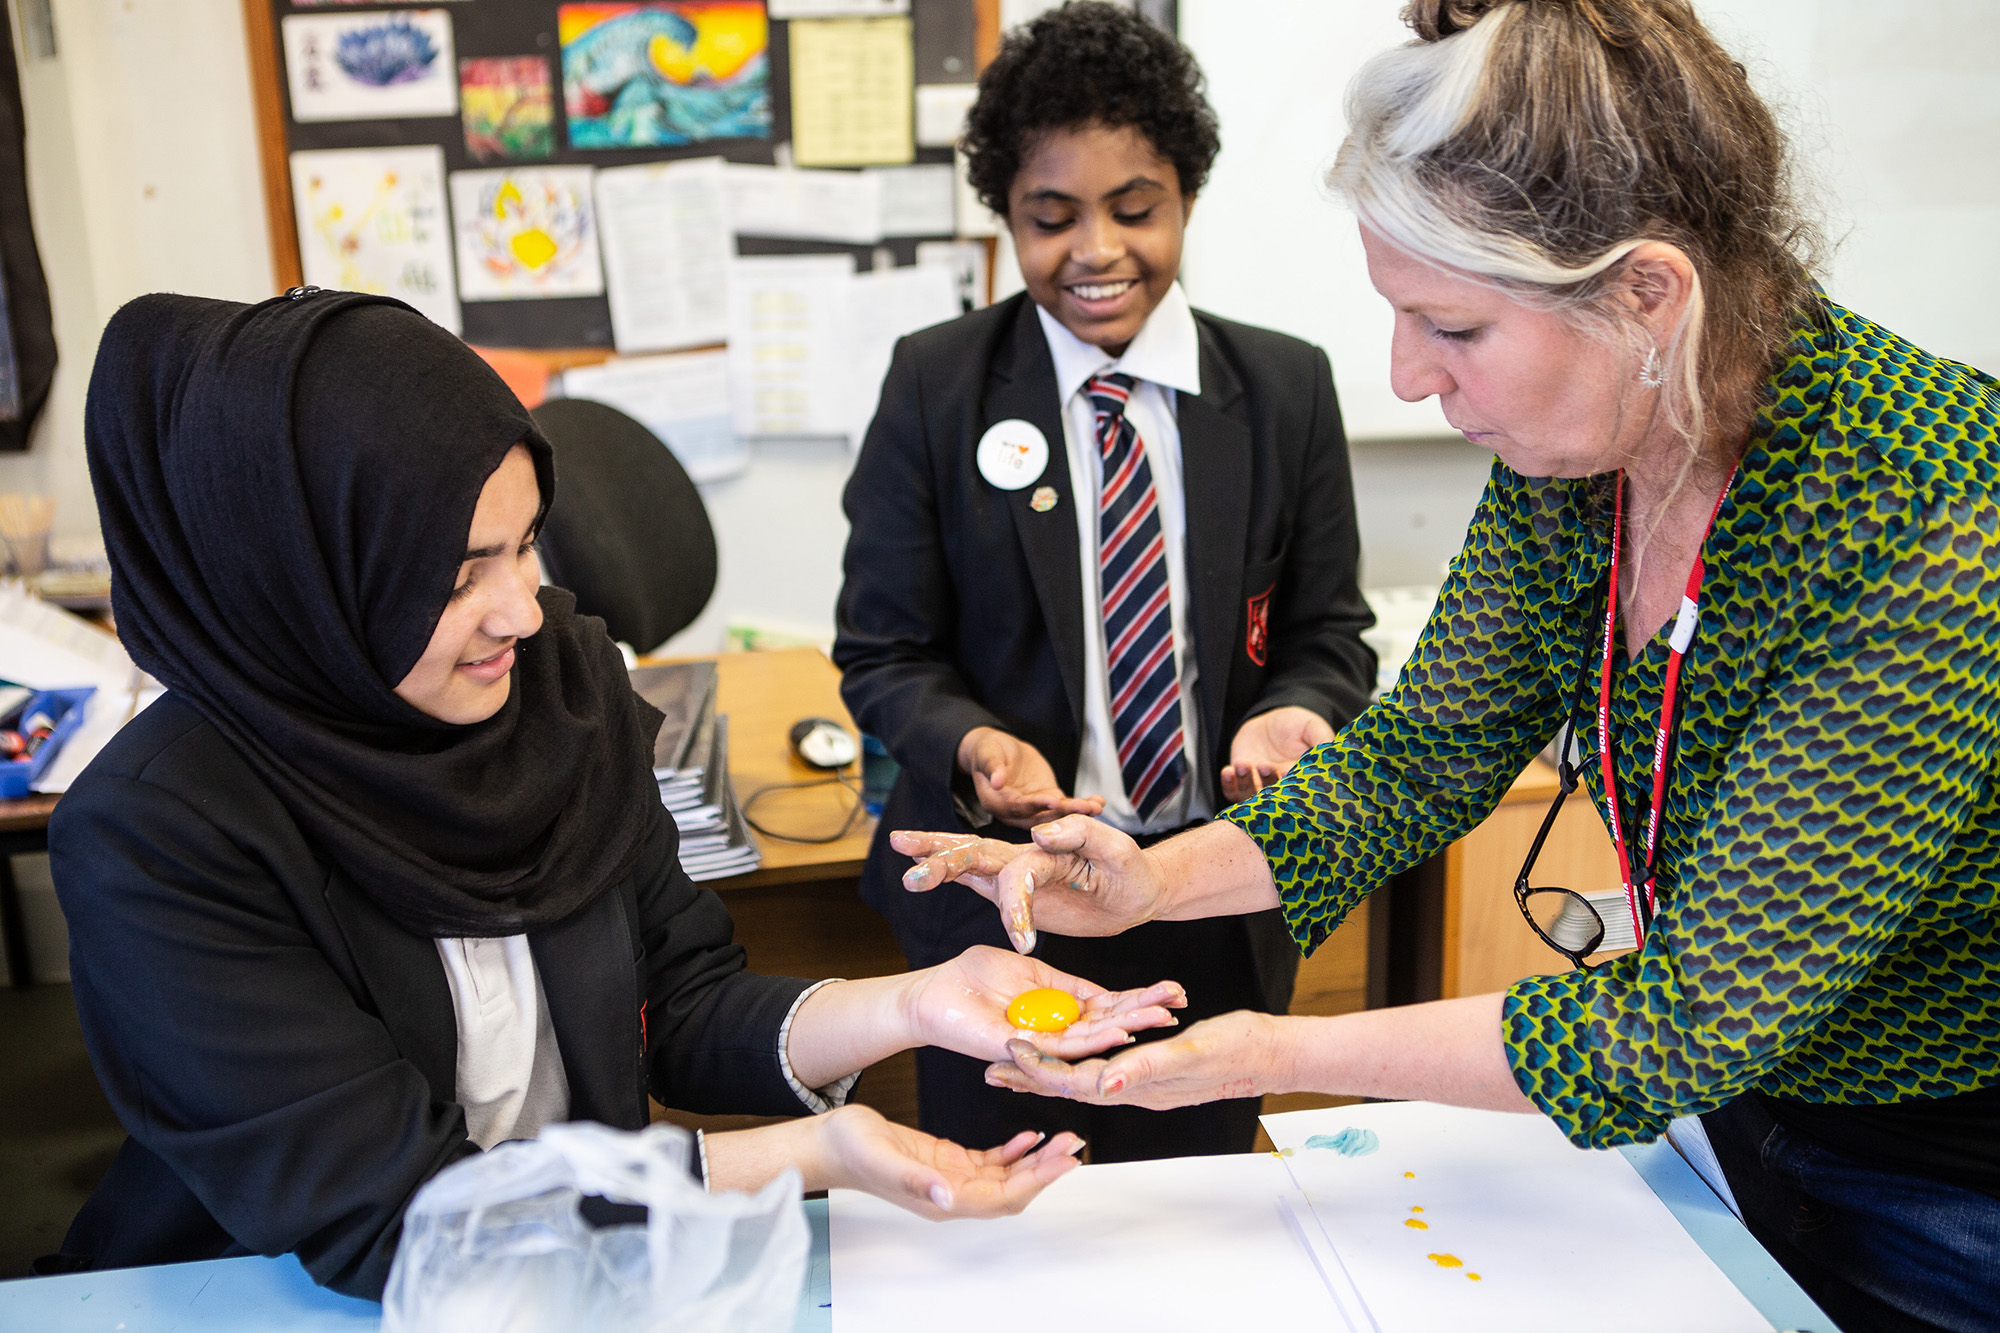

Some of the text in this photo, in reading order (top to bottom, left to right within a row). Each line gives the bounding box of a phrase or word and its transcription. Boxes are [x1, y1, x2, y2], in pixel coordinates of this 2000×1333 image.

[1603, 611, 1611, 660] VISITOR
[1598, 706, 1607, 754] VISITOR
[1653, 727, 1666, 773] VISITOR
[1606, 796, 1620, 842] VISITOR
[1646, 808, 1657, 851] VISITOR
